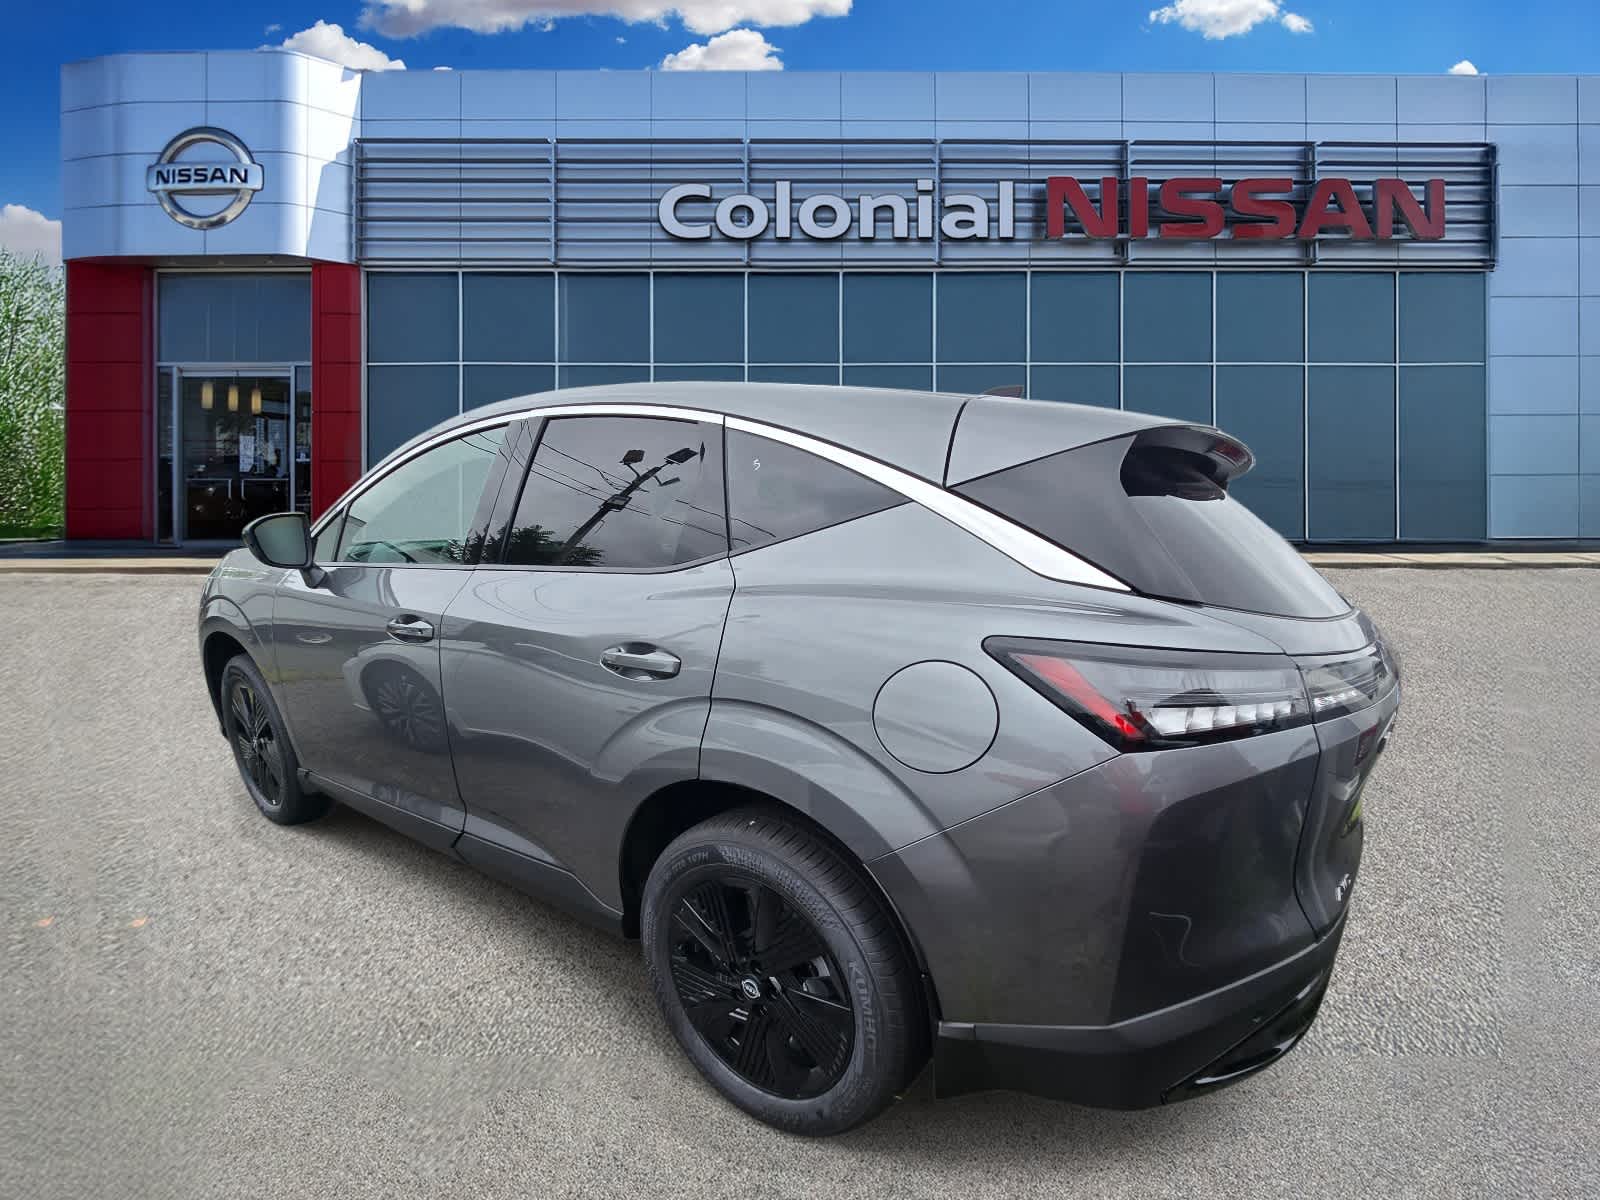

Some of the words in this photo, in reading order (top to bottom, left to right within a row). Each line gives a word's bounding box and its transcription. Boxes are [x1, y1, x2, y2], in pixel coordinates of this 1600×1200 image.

[155, 167, 249, 185] NISSAN
[658, 179, 1015, 240] Colonial
[1046, 176, 1446, 239] NISSAN
